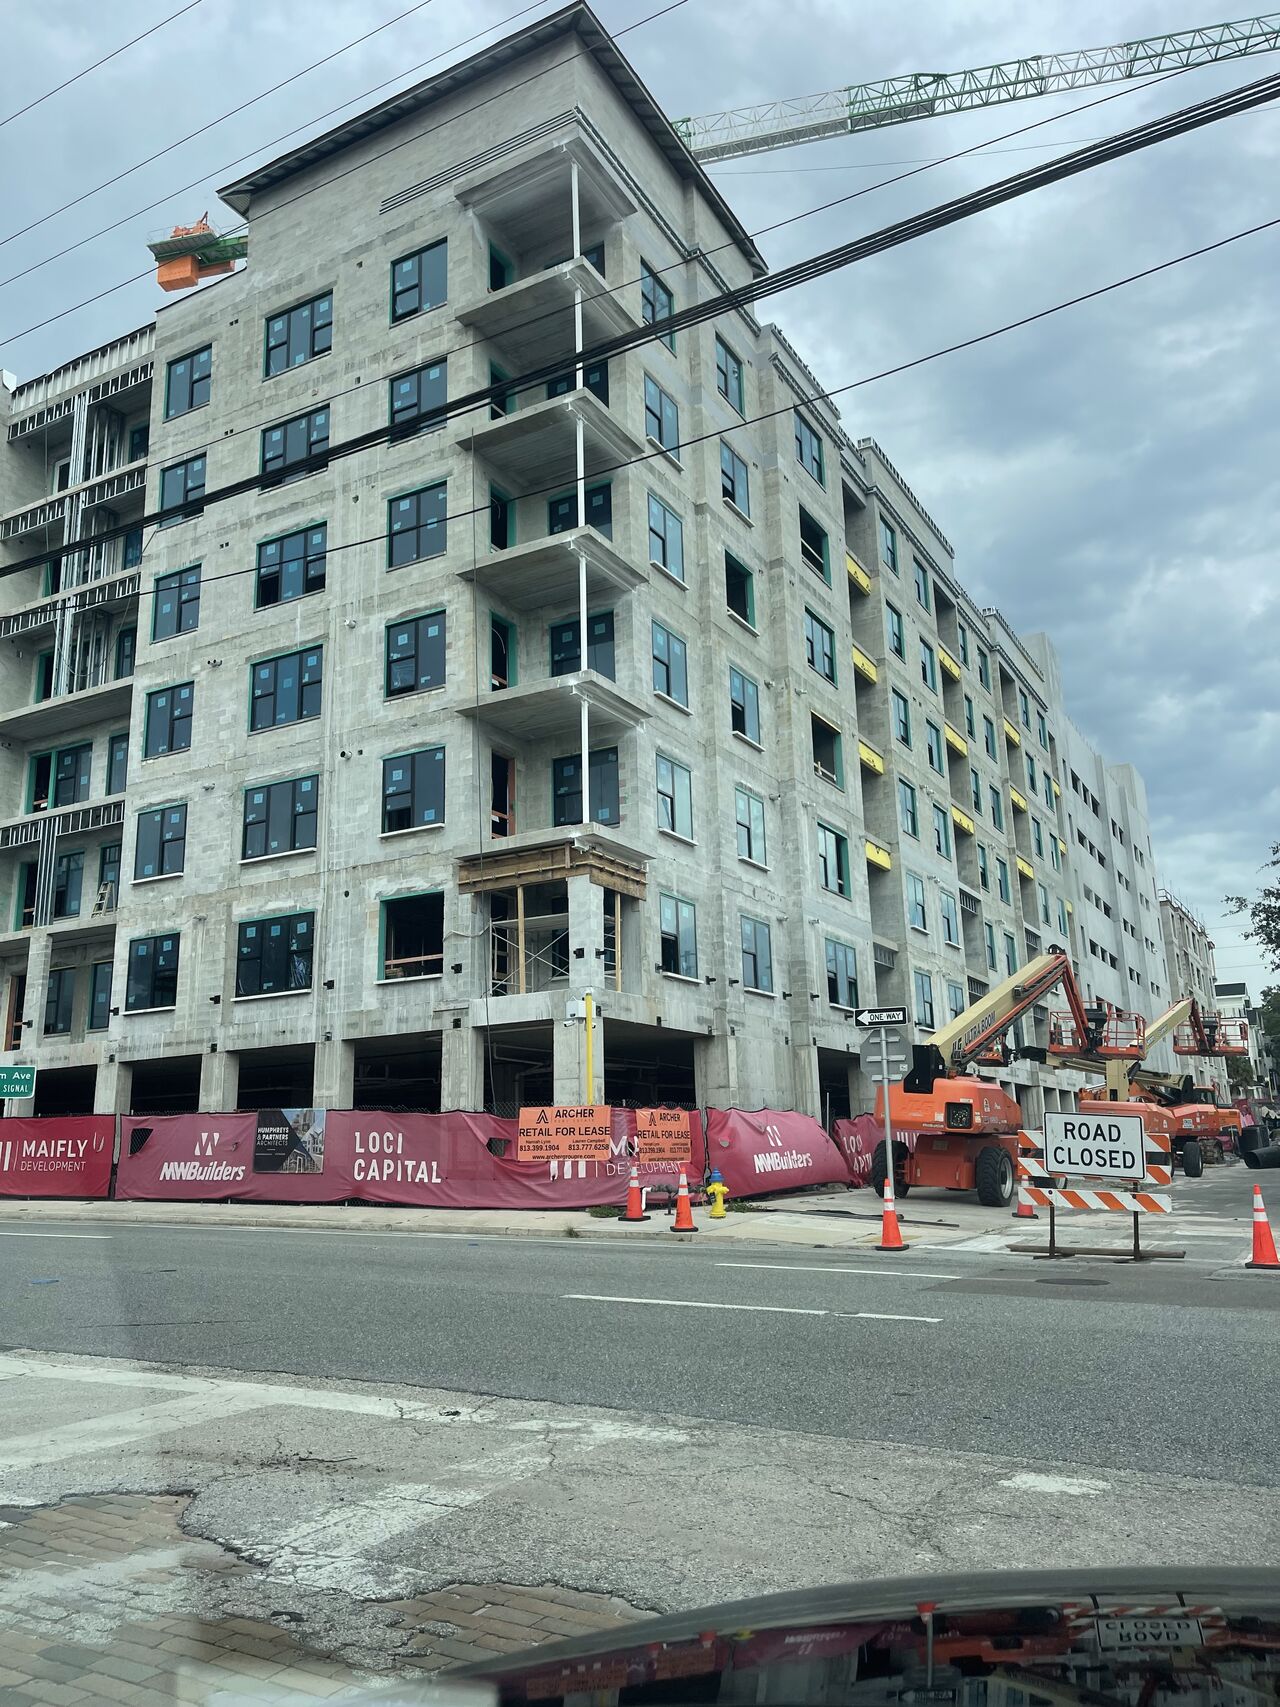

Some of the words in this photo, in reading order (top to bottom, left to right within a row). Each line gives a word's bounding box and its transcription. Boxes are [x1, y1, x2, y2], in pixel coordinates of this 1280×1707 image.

[869, 1013, 884, 1021] ONE
[885, 1012, 901, 1020] WAY
[12, 1071, 31, 1080] Ave
[2, 1084, 28, 1093] SIGNAL
[555, 1108, 594, 1119] ARCHER
[659, 1112, 681, 1122] ARCHER
[262, 1133, 289, 1141] PARTNERS
[519, 1127, 553, 1137] RETAIL
[555, 1127, 576, 1136] FOR
[578, 1126, 611, 1136] LEASE
[637, 1129, 661, 1139] RETAIL
[661, 1130, 673, 1139] FOR
[674, 1130, 690, 1139] LEASE
[1063, 1122, 1121, 1142] ROAD
[22, 1139, 88, 1158] MAIFLY
[355, 1131, 403, 1155] LOCI
[519, 1144, 560, 1152] 813.399.1904
[568, 1143, 610, 1151] 813.777.6258
[753, 1150, 813, 1174] MWBuilders
[1053, 1146, 1136, 1170] CLOSED
[20, 1160, 87, 1172] DEVELOPMENT
[159, 1160, 246, 1181] MWBuilders
[353, 1158, 442, 1185] CAPITAL
